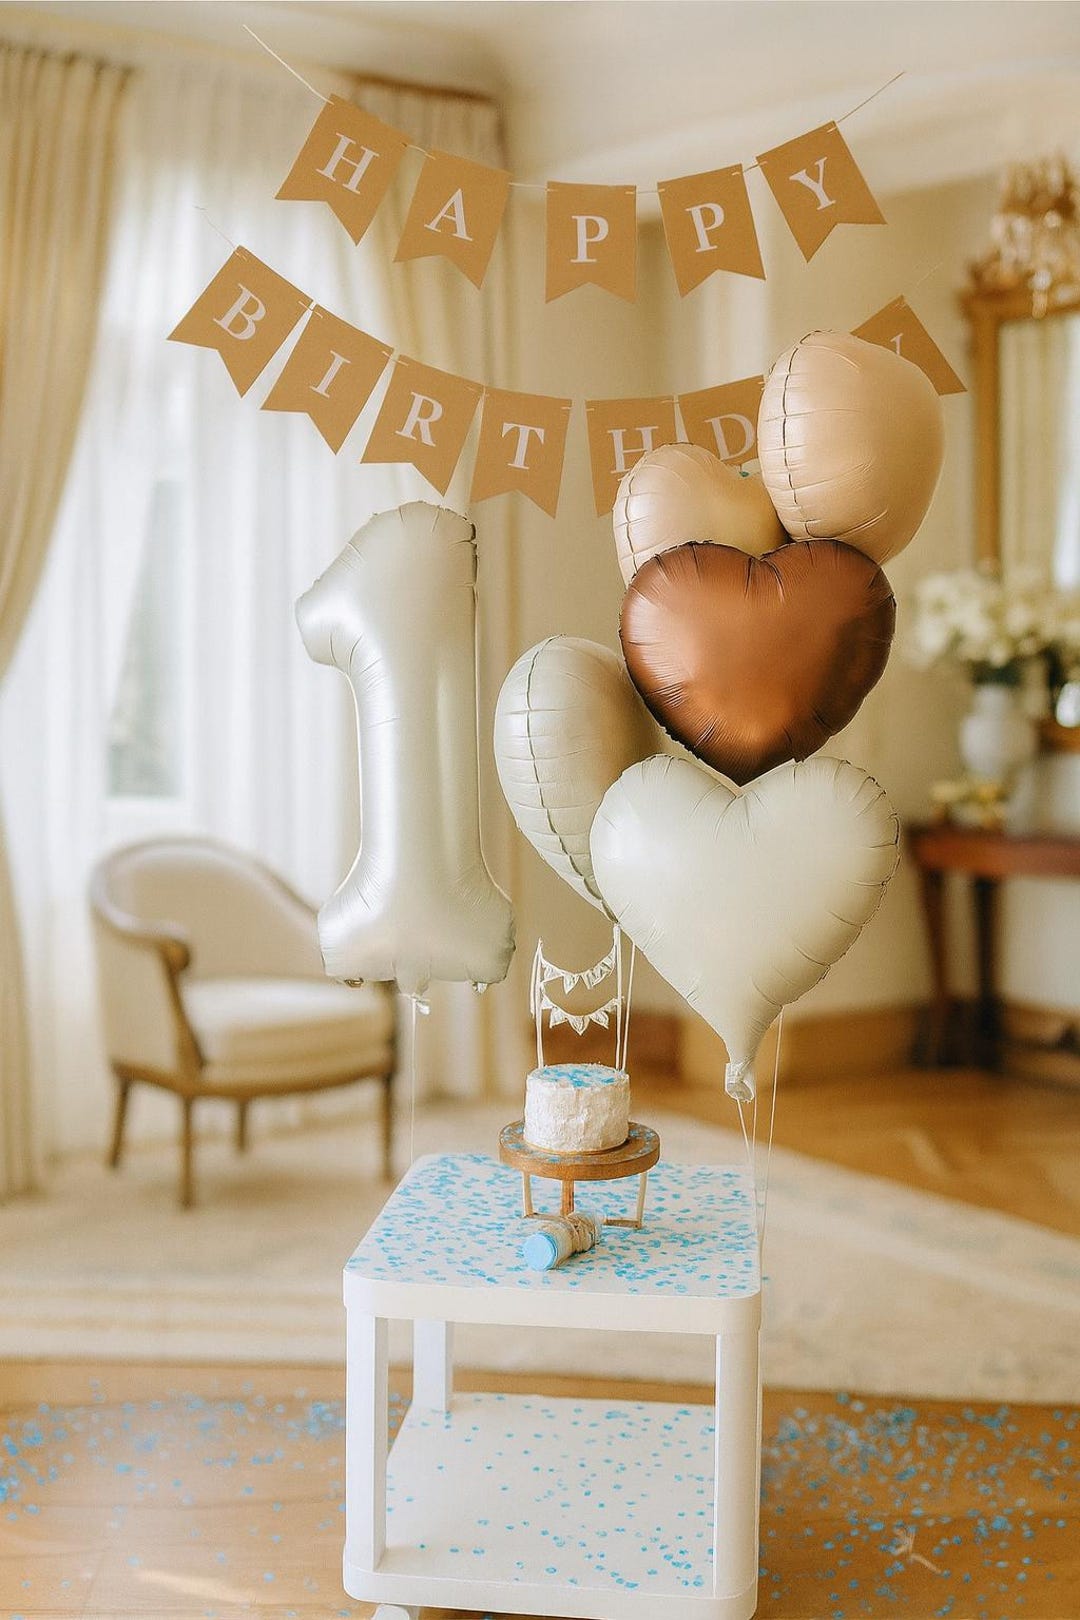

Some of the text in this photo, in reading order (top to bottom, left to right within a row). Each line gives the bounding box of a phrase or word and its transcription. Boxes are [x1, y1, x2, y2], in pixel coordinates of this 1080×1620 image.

[315, 132, 839, 264] HAPPY
[212, 283, 903, 473] BIRTHD
[296, 501, 516, 994] 1
